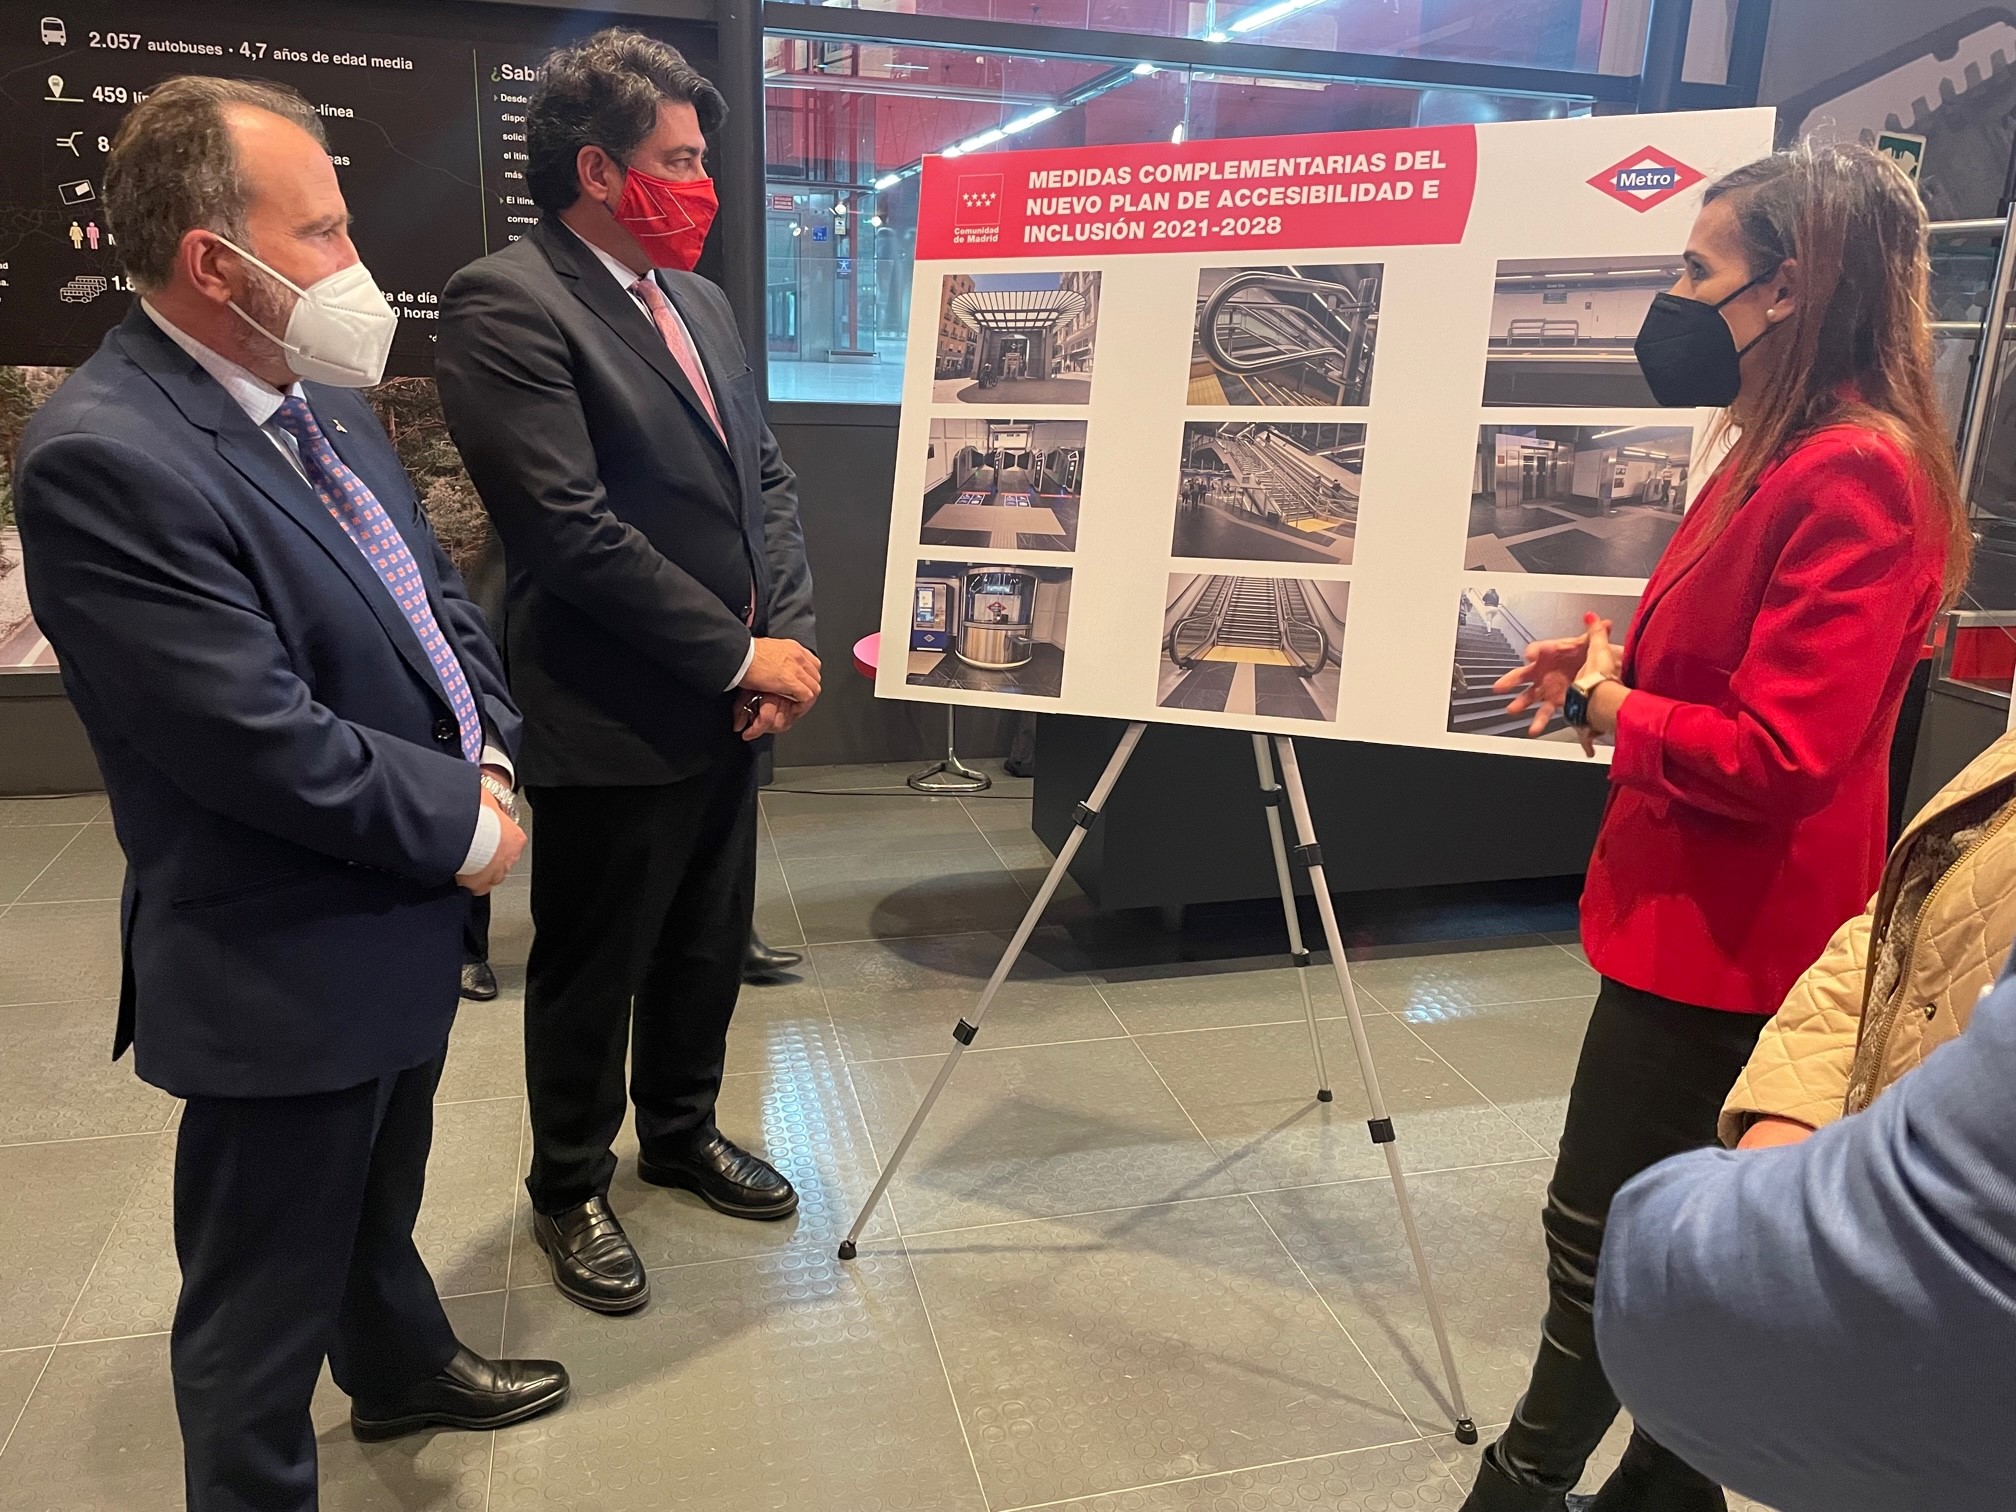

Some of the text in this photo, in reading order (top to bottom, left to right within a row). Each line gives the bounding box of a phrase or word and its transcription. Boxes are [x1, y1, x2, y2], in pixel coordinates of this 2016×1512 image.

[88, 31, 413, 70] 2.057 autobuses 4,7 años de edad media
[92, 86, 128, 103] 459
[500, 93, 528, 104] Desde
[501, 113, 528, 124] dispo
[503, 151, 512, 160] el
[504, 170, 523, 180] más
[1028, 149, 1446, 189] MEDIDAS COMPLEMENTARIAS DEL
[1620, 172, 1671, 187] Metro
[506, 195, 515, 205] El
[1026, 180, 1440, 216] NUEVO PLAN DE ACCESIBILIDAD E
[954, 226, 999, 235] Comunidad
[1023, 216, 1282, 243] INCLUSIÓN 2021-2028
[953, 234, 999, 244] de Madrid
[397, 290, 414, 303] de
[417, 291, 438, 304] día
[404, 306, 440, 320] horas
